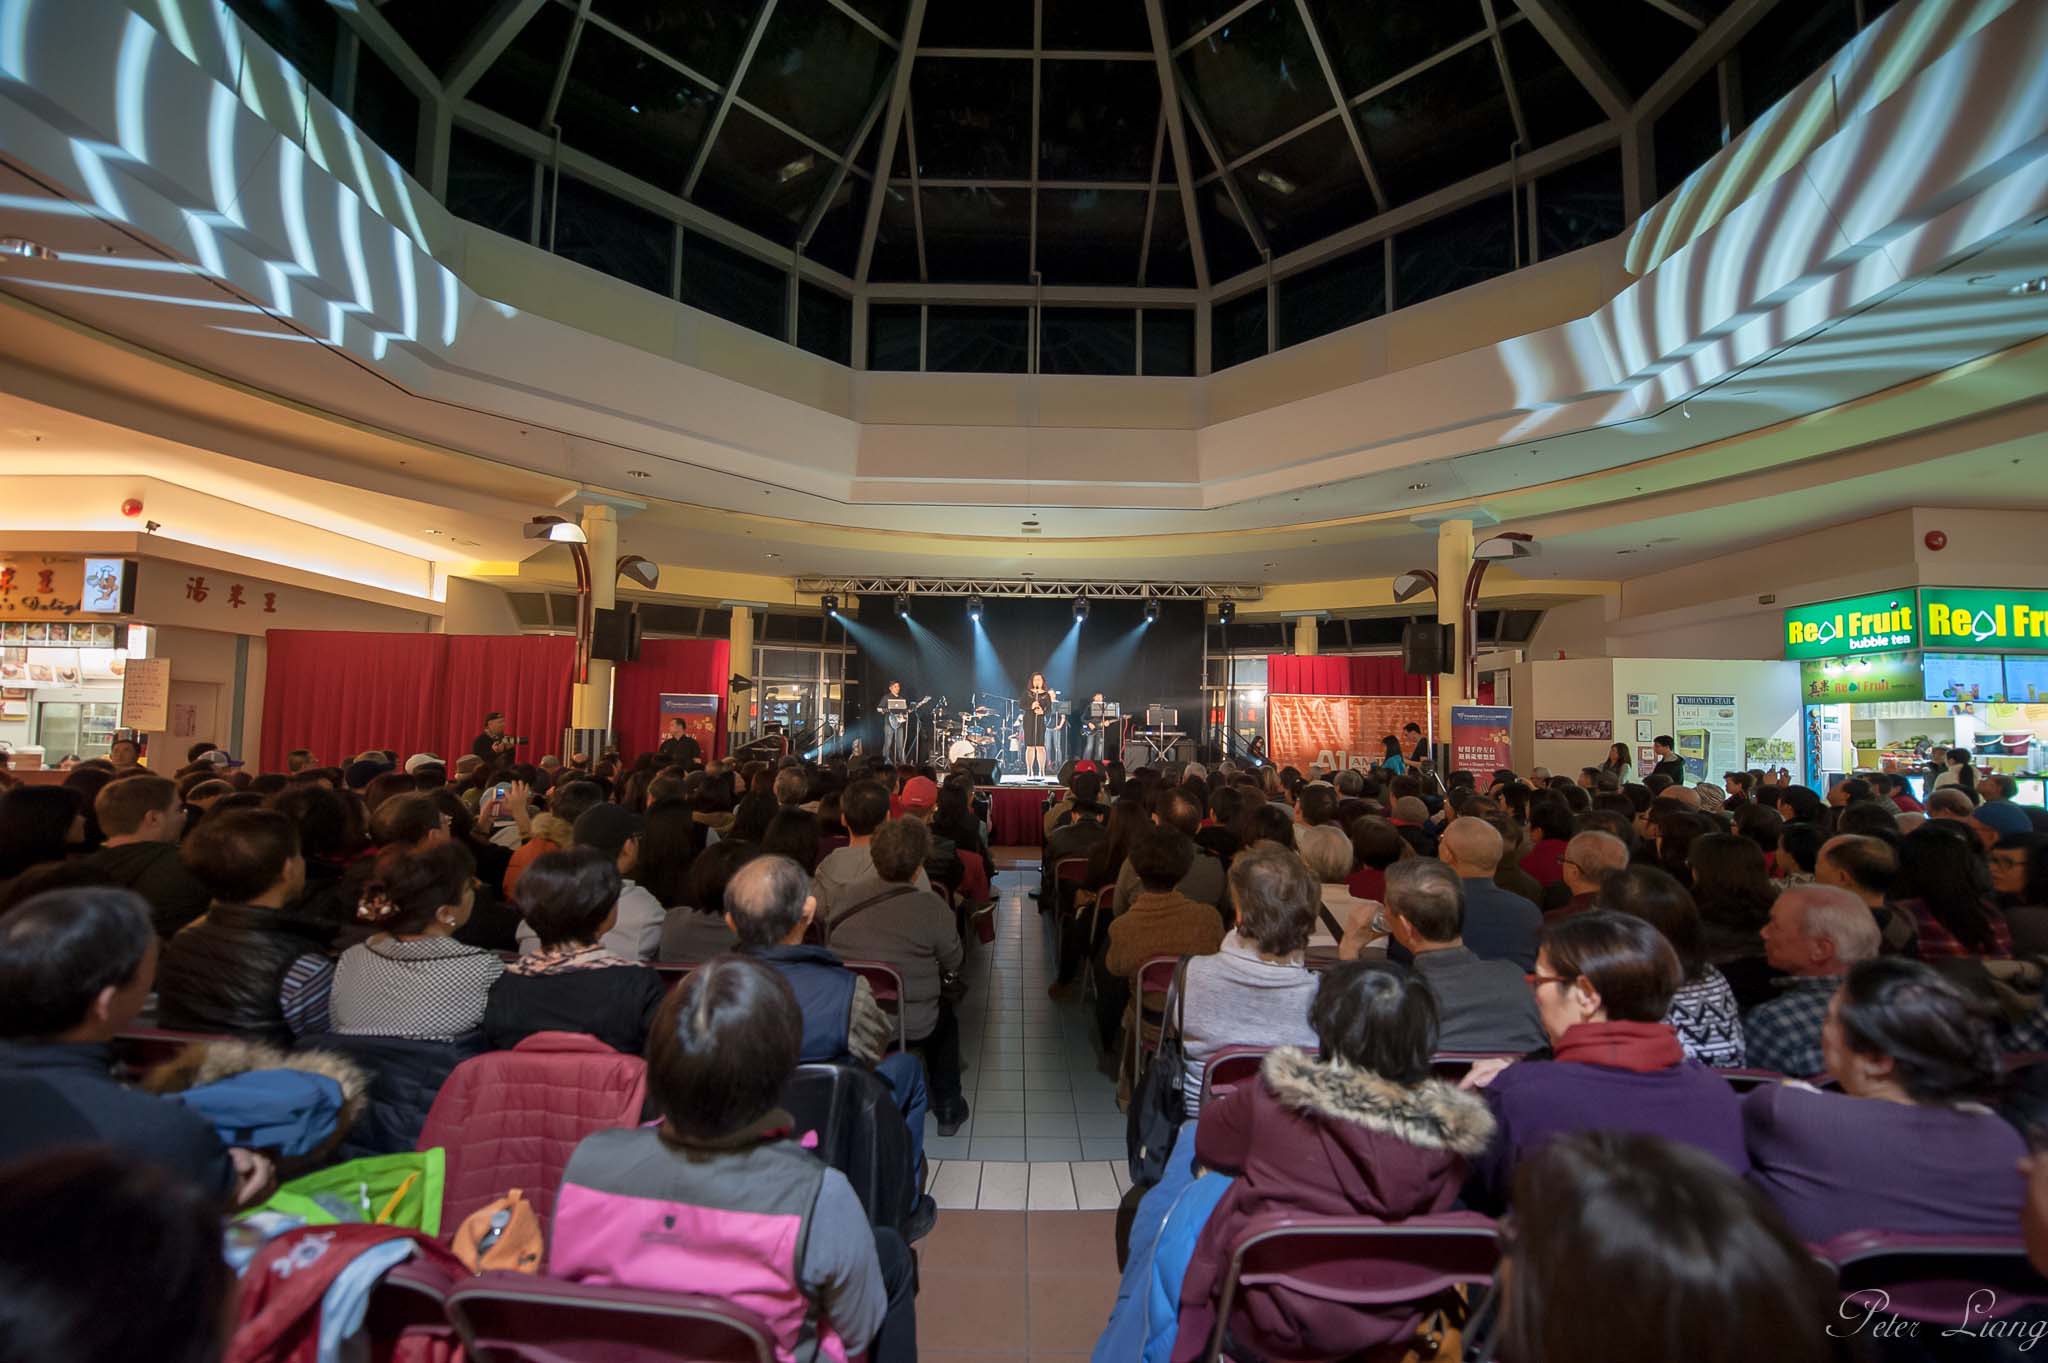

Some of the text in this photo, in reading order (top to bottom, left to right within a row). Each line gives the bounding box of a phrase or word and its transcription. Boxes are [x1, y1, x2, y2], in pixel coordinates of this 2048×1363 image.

[1788, 601, 1913, 645] Real Fruit
[1928, 603, 2048, 642] Real Fr
[1849, 635, 1911, 650] bubble tea
[1864, 678, 1889, 693] Fruit
[1680, 696, 1731, 705] TORONTO STAR
